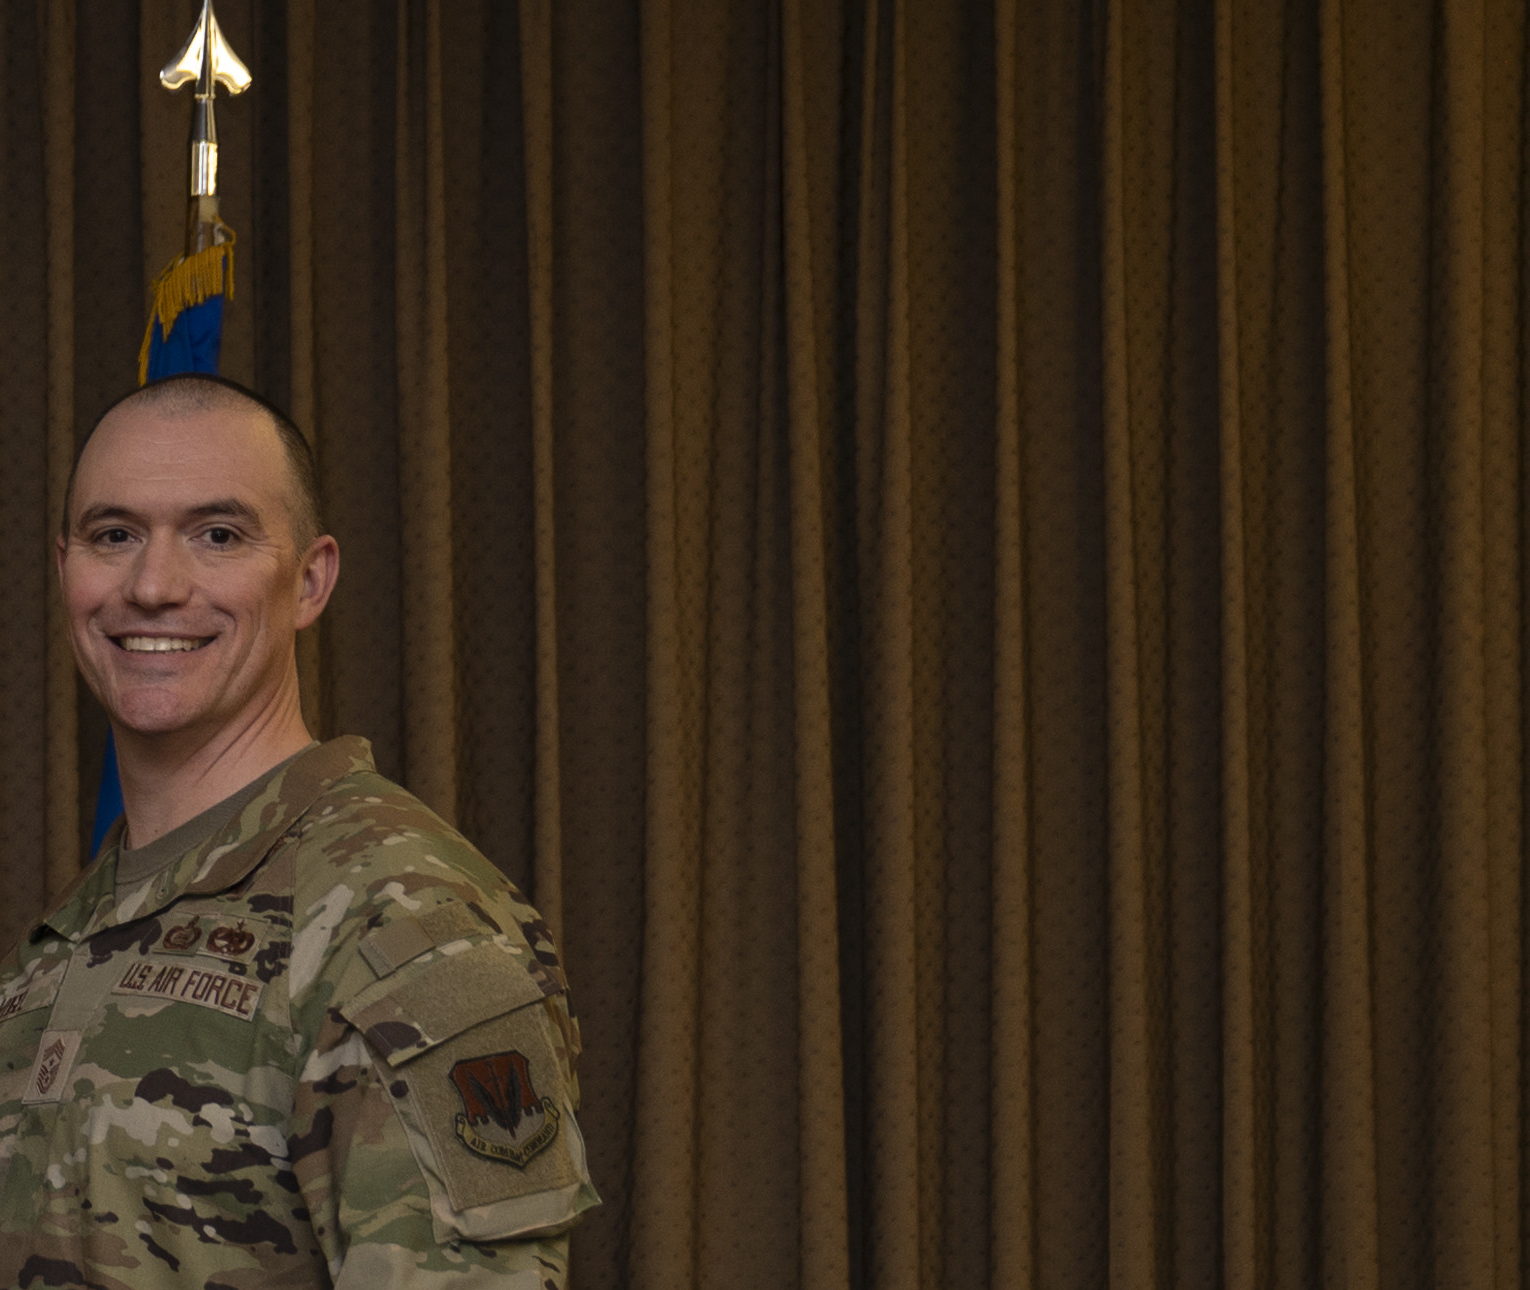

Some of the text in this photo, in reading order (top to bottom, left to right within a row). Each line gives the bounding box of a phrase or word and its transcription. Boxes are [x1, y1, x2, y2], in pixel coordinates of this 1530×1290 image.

[147, 965, 184, 995] AIR
[180, 970, 259, 1016] FORCE
[470, 1122, 555, 1163] AIR COMBAT COMMAND
